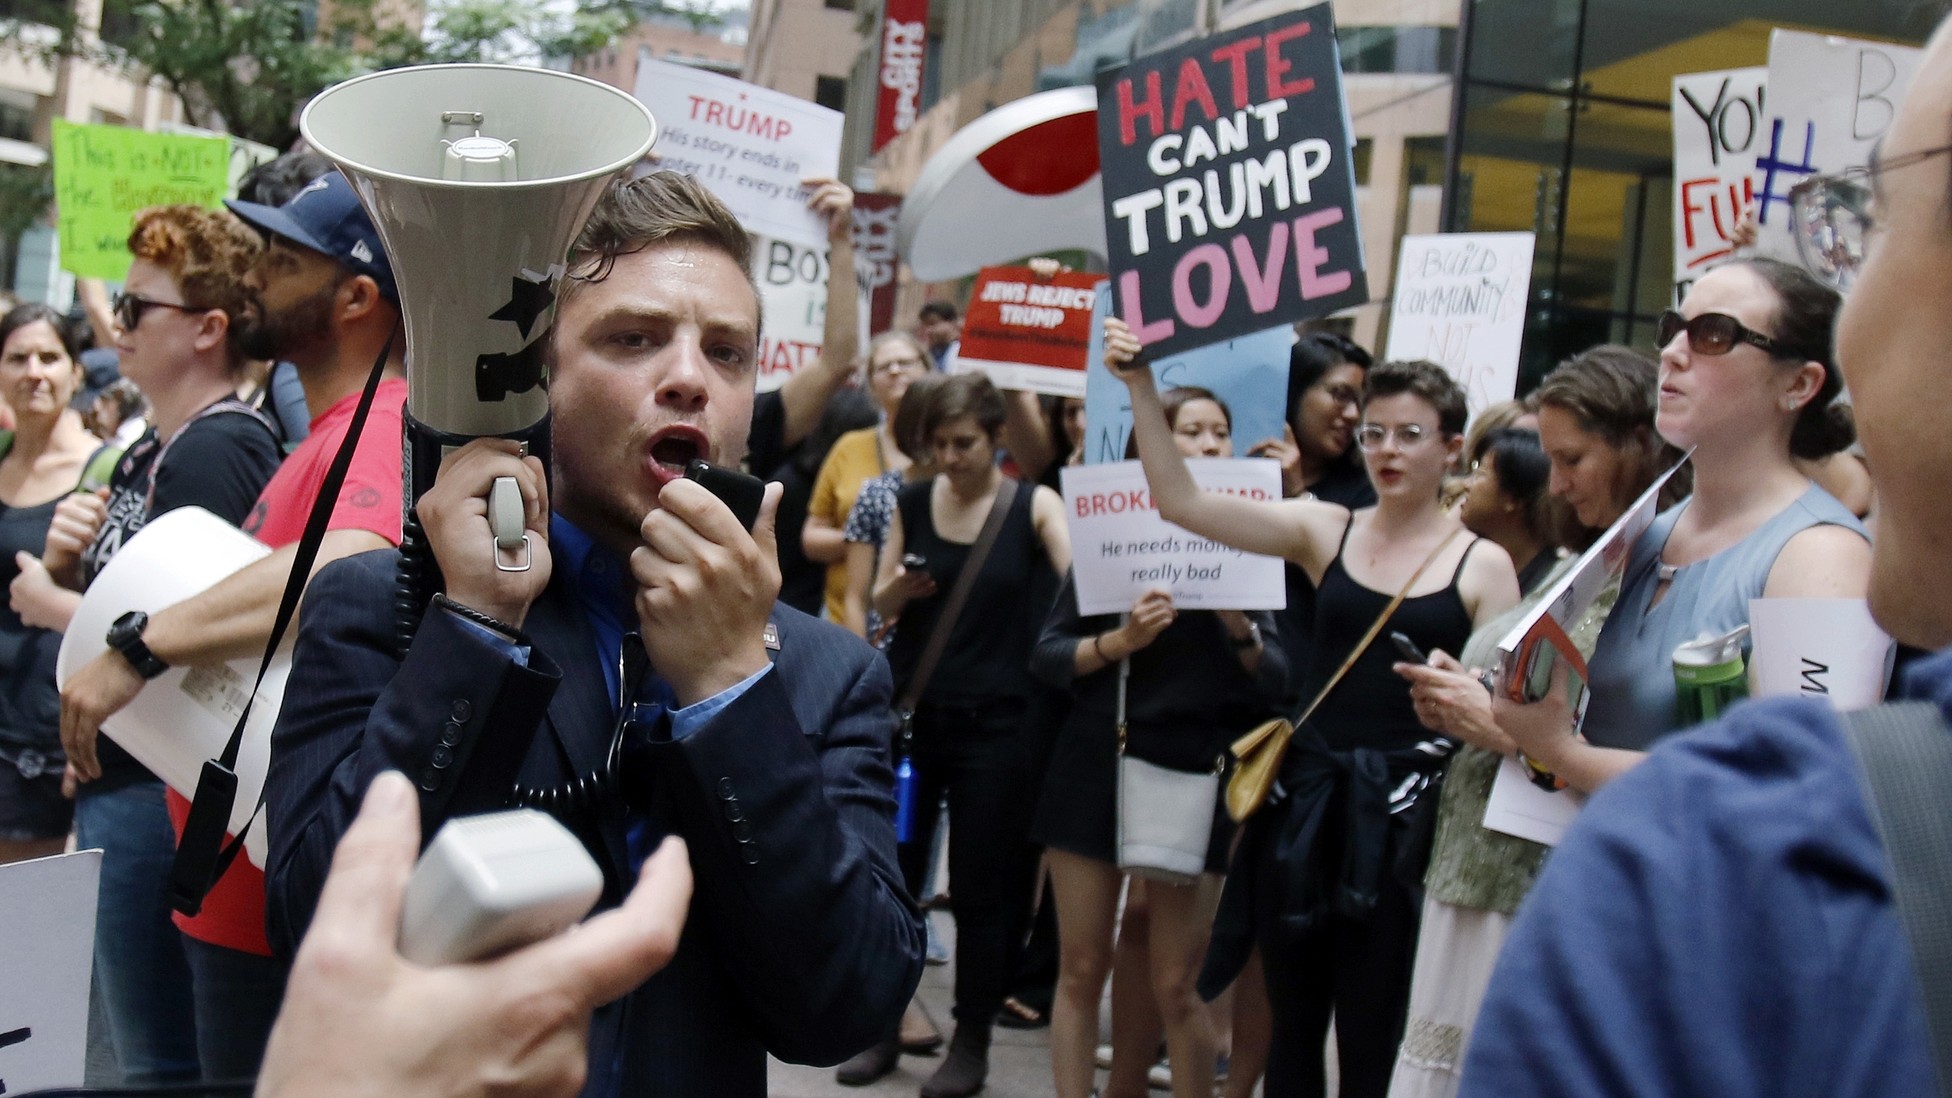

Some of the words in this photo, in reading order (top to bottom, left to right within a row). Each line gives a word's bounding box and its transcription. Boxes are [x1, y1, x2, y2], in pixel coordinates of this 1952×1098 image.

[1116, 21, 1316, 146] HATE
[688, 94, 793, 142] TRUMP
[1147, 98, 1289, 177] CAN'T
[660, 125, 689, 146] His
[693, 135, 739, 160] story
[740, 149, 780, 170] ends
[783, 155, 801, 174] in
[736, 173, 783, 199] every
[1112, 138, 1332, 257] TRUMP
[1681, 175, 1754, 249] FU
[767, 239, 829, 286] BO
[1119, 206, 1352, 346] LOVE
[980, 280, 1028, 303] JEWS
[1027, 284, 1096, 311] REJECT
[1000, 303, 1066, 330] TRUMP
[1101, 540, 1123, 559] He
[1127, 536, 1181, 556] needs
[1186, 539, 1244, 558] mon
[1131, 563, 1183, 584] really
[1187, 563, 1222, 581] bad
[1801, 657, 1829, 697] M
